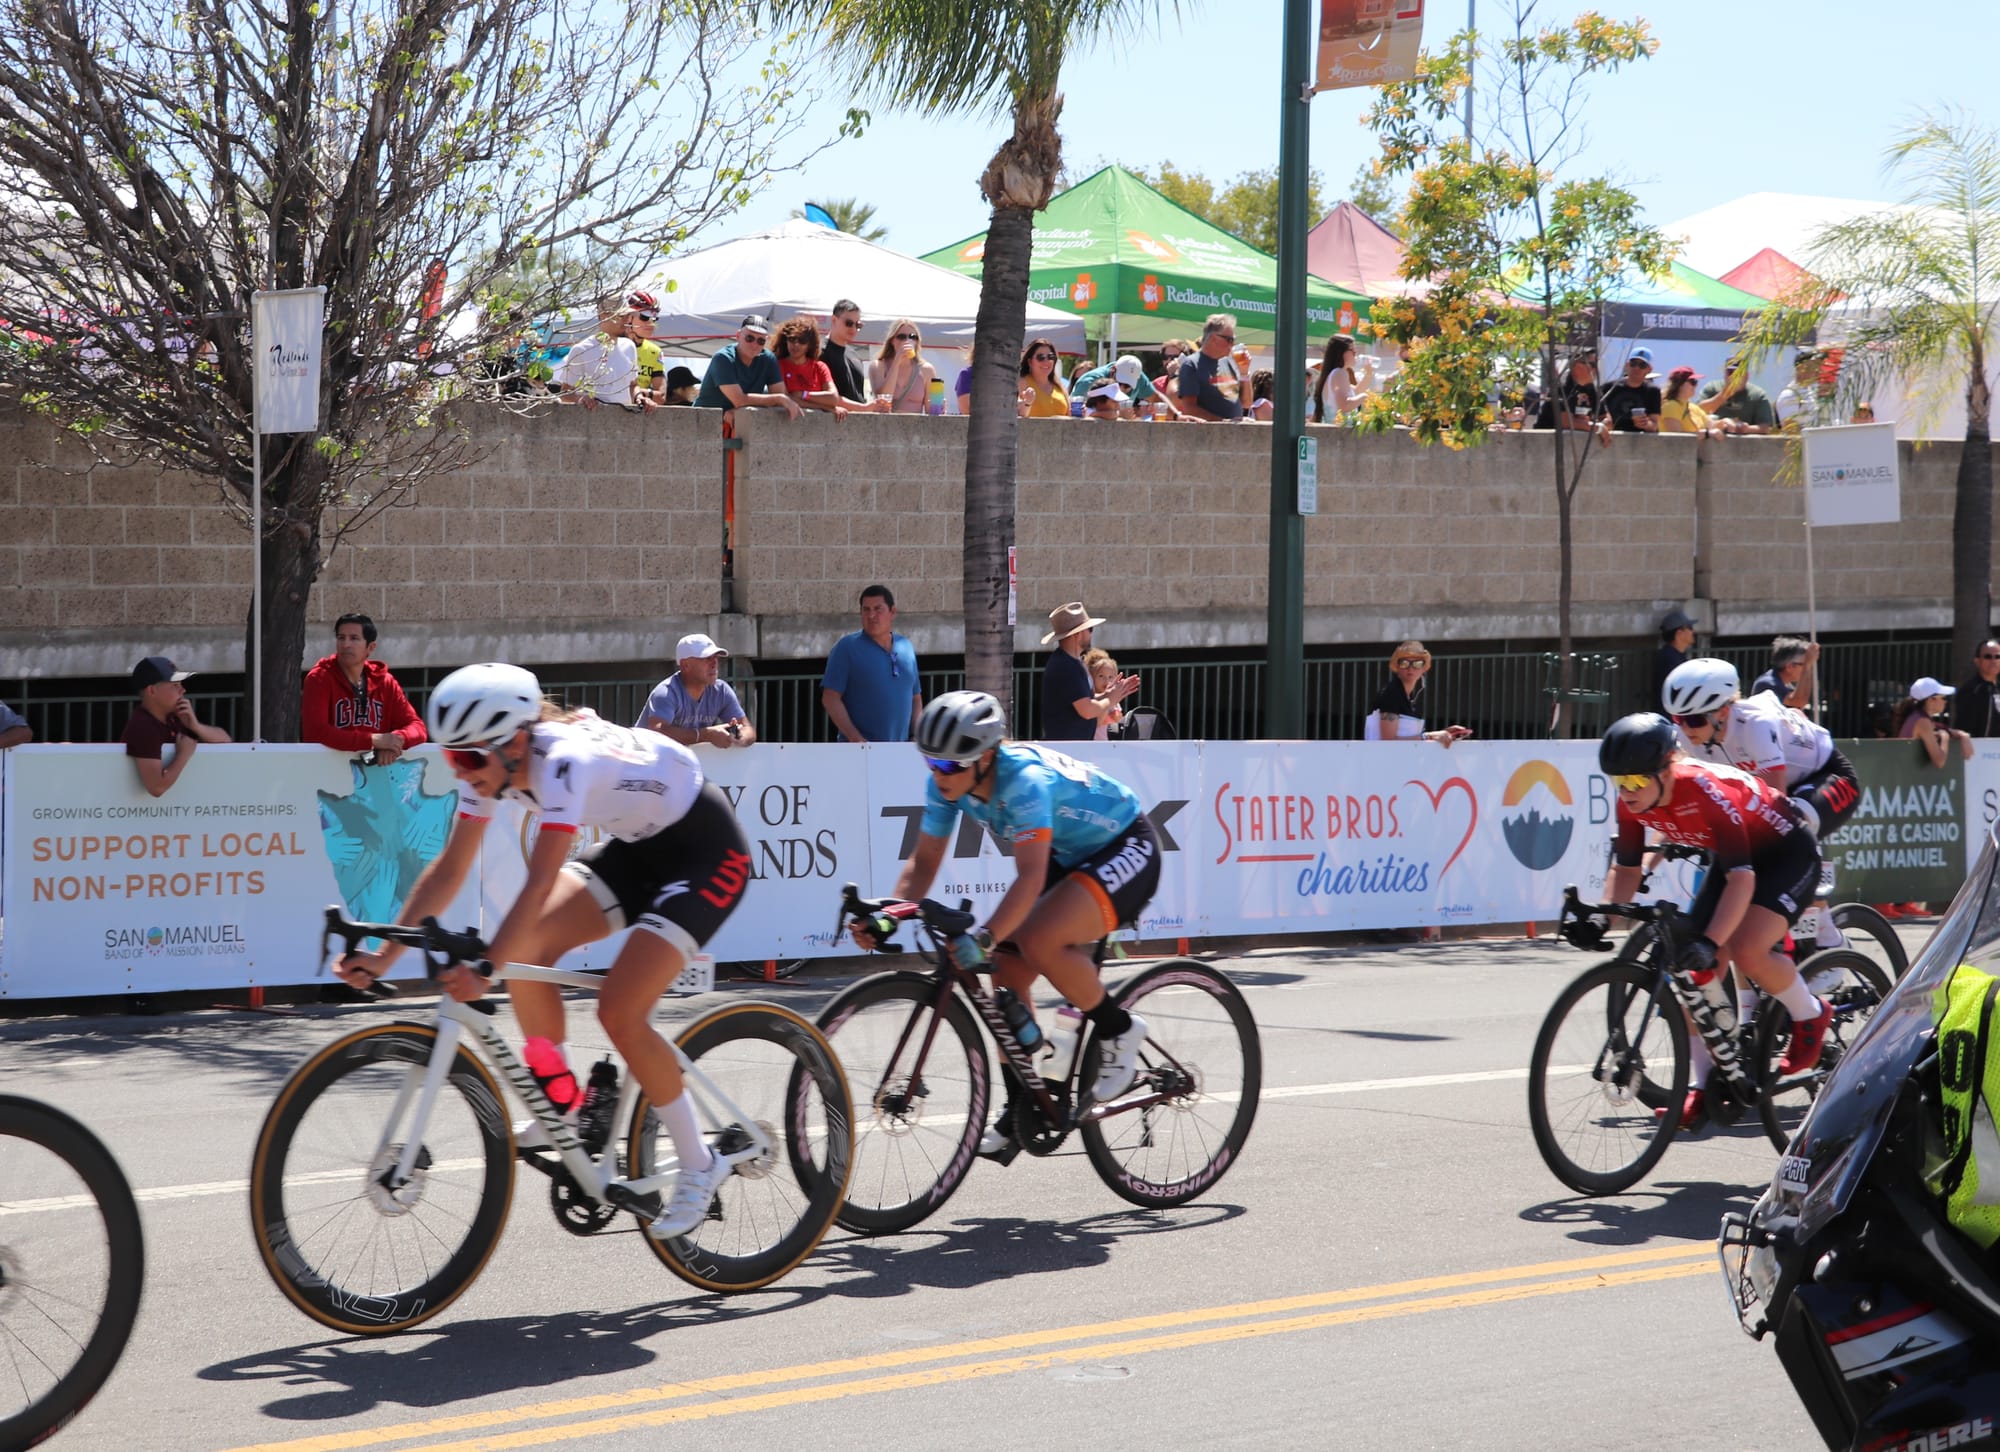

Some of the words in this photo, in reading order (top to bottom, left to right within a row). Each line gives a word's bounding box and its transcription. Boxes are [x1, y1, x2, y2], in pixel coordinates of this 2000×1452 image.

[1028, 283, 1067, 303] ospital
[1166, 284, 1220, 307] Redlands
[1307, 305, 1334, 323] spital
[1642, 312, 1659, 328] THE
[1658, 313, 1703, 329] EVERYTHING
[1845, 466, 1893, 479] MANUEL
[32, 807, 103, 820] GROWING
[107, 806, 190, 819] COMMUNITY
[194, 804, 297, 817] PARTNERSHIPS:
[760, 785, 811, 826] OF
[1215, 782, 1316, 865] STATER
[1327, 794, 1404, 840] BROS.
[1886, 824, 1898, 843] &
[1901, 823, 1960, 844] CASINO
[32, 834, 191, 862] SUPPORT
[202, 832, 306, 857] LOCAL
[1845, 850, 1878, 870] SAN
[1882, 847, 1947, 868] MANUEL
[1096, 837, 1153, 894] SDBC
[1297, 851, 1429, 897] charities
[33, 871, 265, 901] NON-PROFITS
[699, 848, 752, 908] LUX
[944, 884, 970, 895] RIDE
[975, 882, 1007, 893] BIKES
[105, 928, 144, 948] SAN
[165, 925, 245, 945] MANUEL
[104, 948, 131, 960] BAND
[132, 948, 144, 958] OF
[166, 946, 203, 957] MISSION
[208, 944, 246, 955] INDIANS
